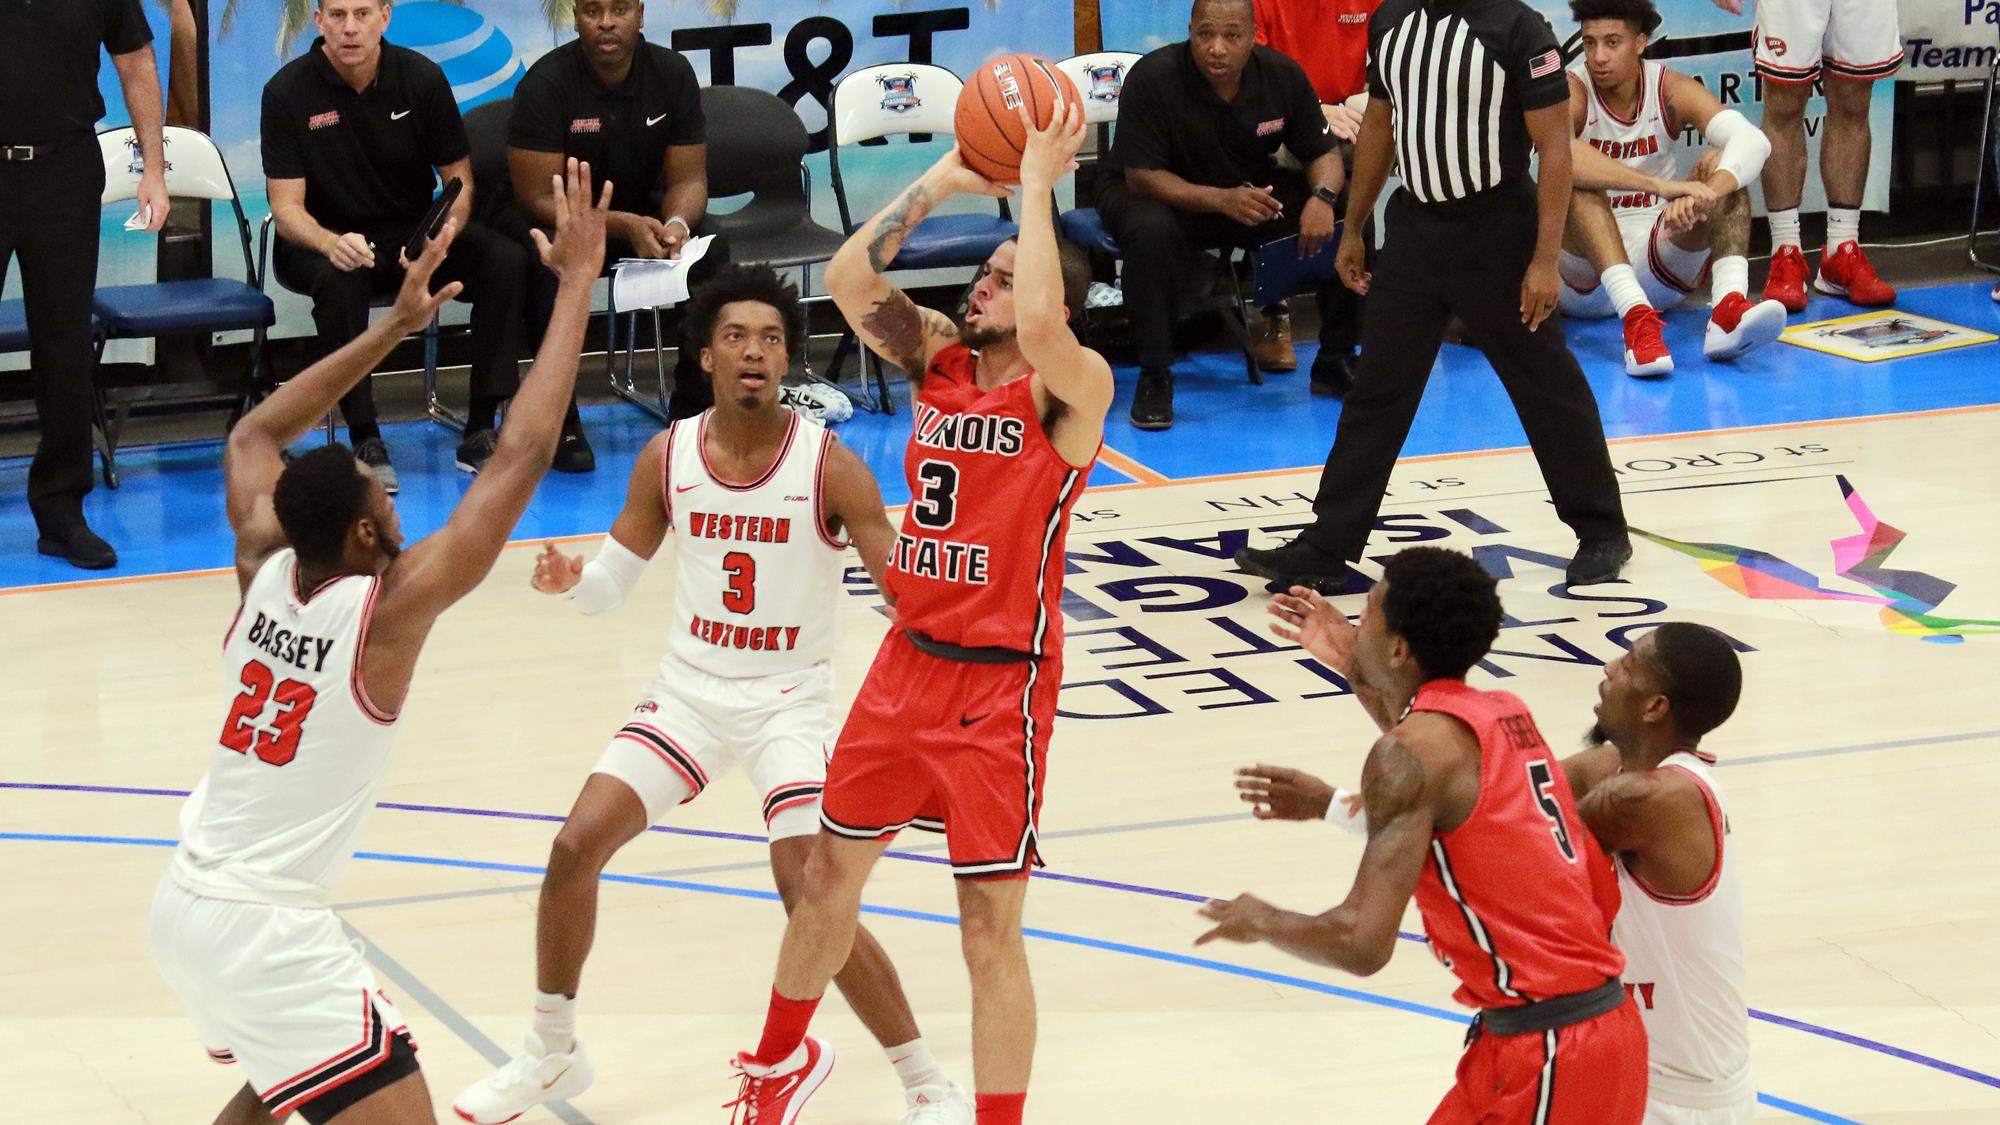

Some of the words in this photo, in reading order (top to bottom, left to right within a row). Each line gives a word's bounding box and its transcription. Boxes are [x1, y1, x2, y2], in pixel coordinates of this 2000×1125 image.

[1615, 451, 1765, 475] CRO
[912, 458, 960, 531] 3
[690, 511, 791, 543] WESTERN
[722, 551, 756, 615] 3
[887, 534, 989, 585] TATE
[248, 611, 335, 672] BASSEY
[690, 613, 800, 651] KENTUCKY
[219, 658, 318, 767] 23
[1525, 759, 1578, 864] 5
